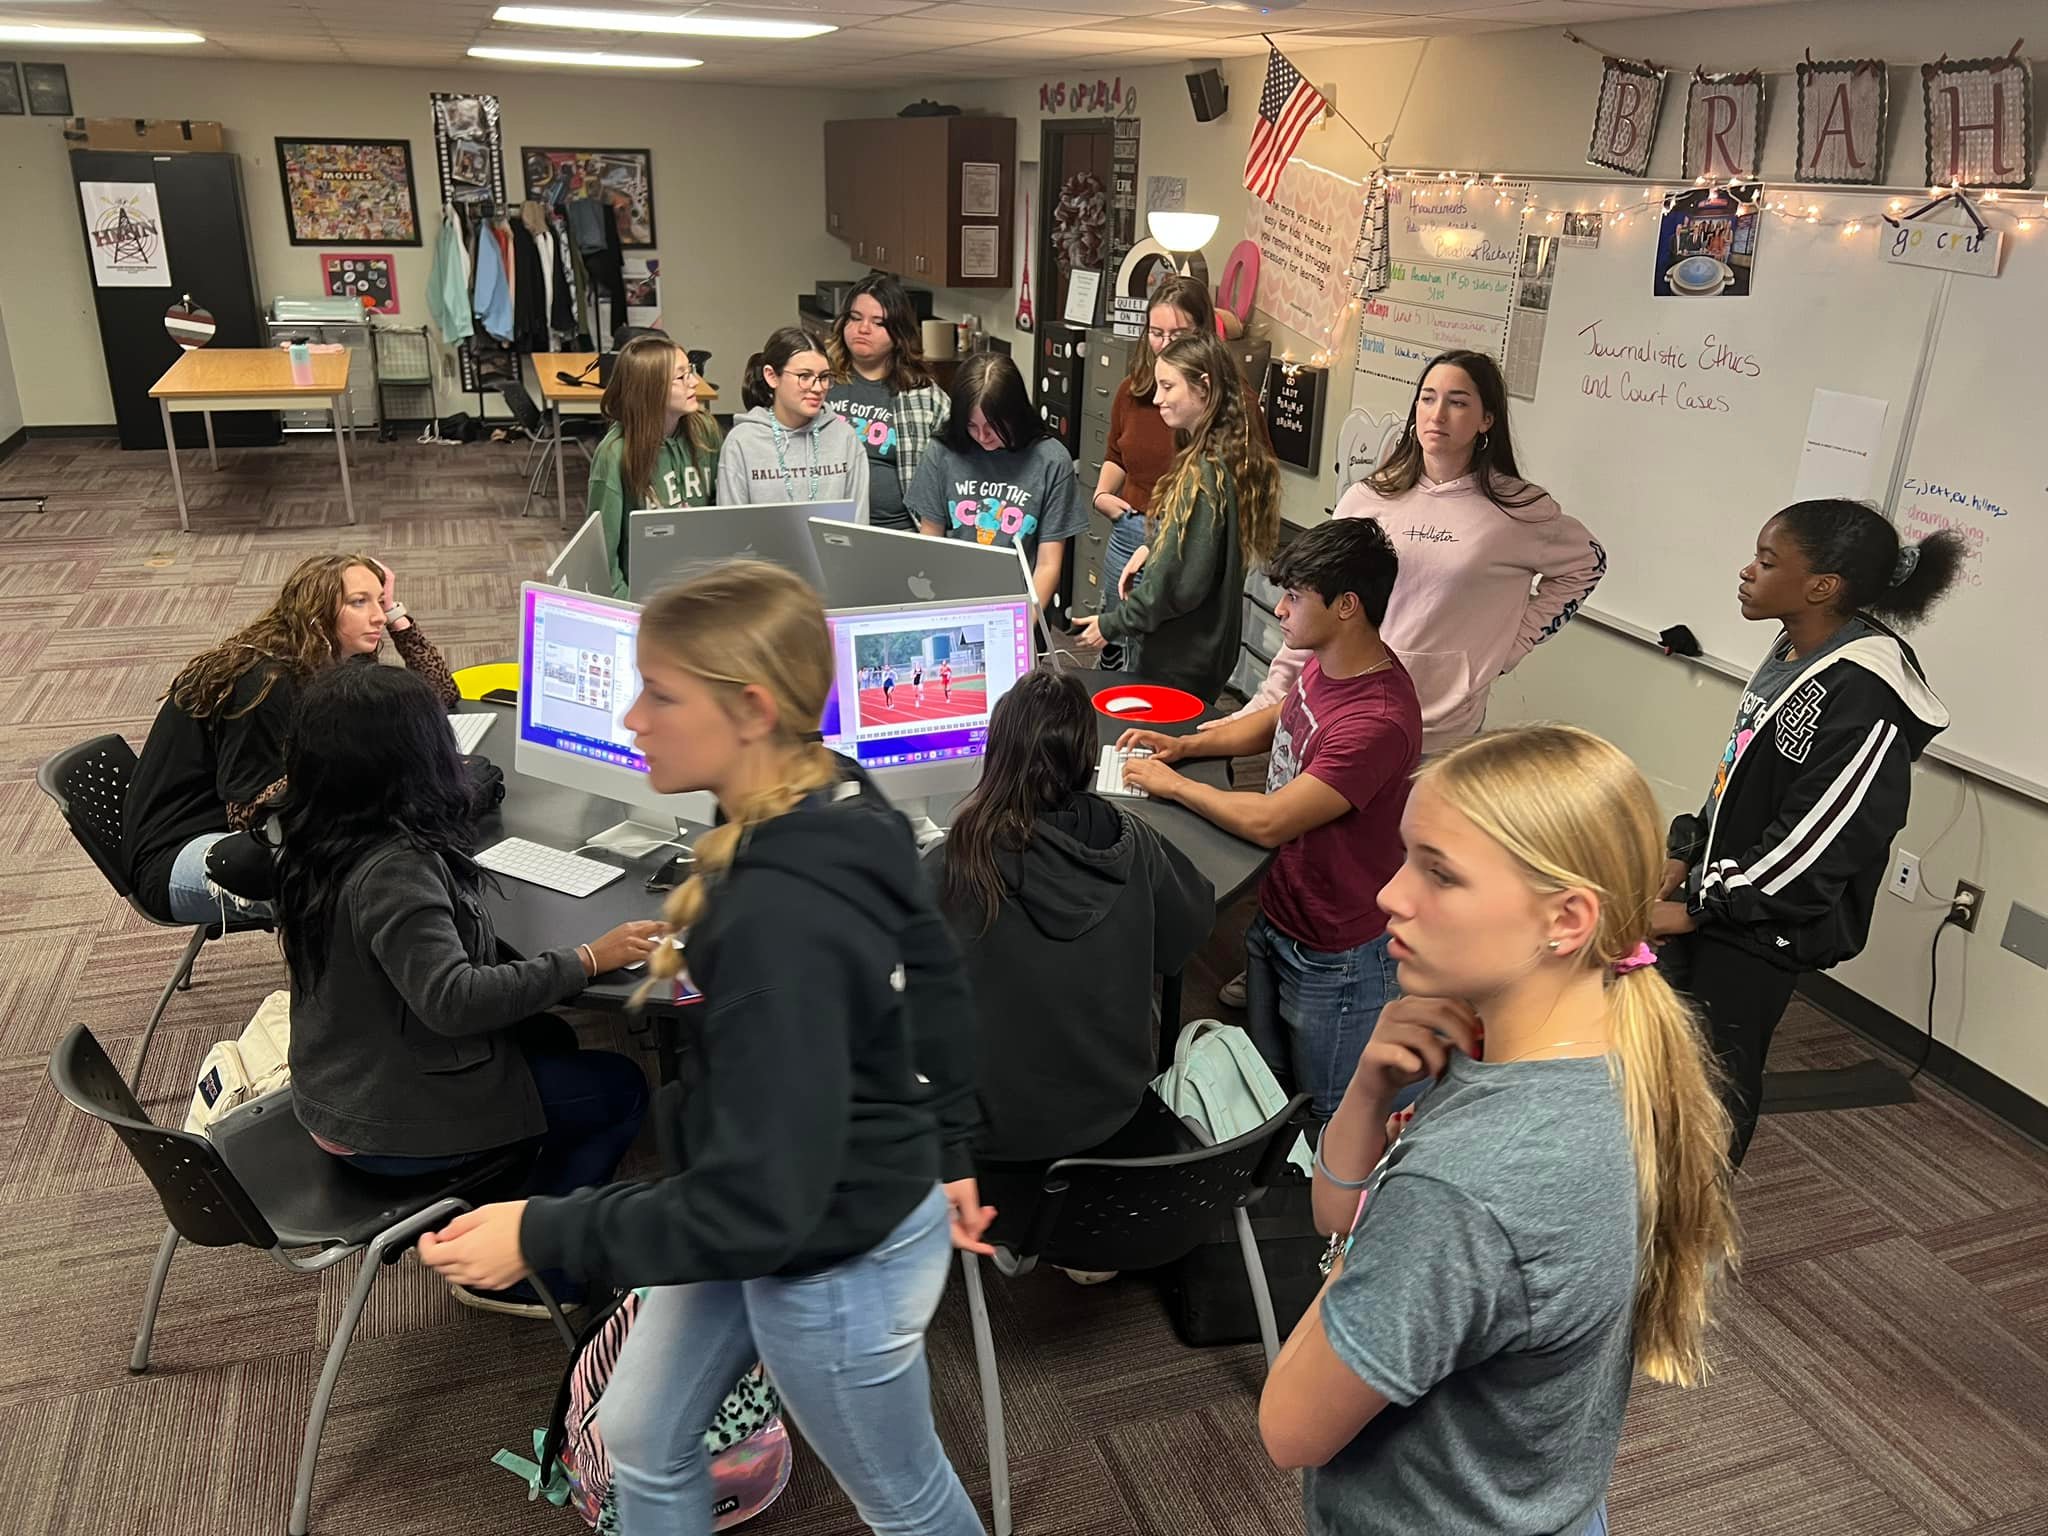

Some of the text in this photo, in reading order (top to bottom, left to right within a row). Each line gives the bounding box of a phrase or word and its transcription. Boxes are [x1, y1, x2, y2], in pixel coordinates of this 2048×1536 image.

[323, 171, 373, 180] MOVIES
[1296, 213, 1307, 225] you
[1892, 228, 1922, 257] go
[1116, 299, 1143, 309] QUIET
[1120, 311, 1131, 321] ON
[1578, 319, 1688, 368] Journalistic
[1699, 334, 1761, 377] Ethics
[1581, 370, 1730, 413] and Court Cases
[830, 400, 893, 422] WE GOT THE
[955, 481, 1032, 507] WE GOT THE
[1402, 523, 1461, 543] Hollister
